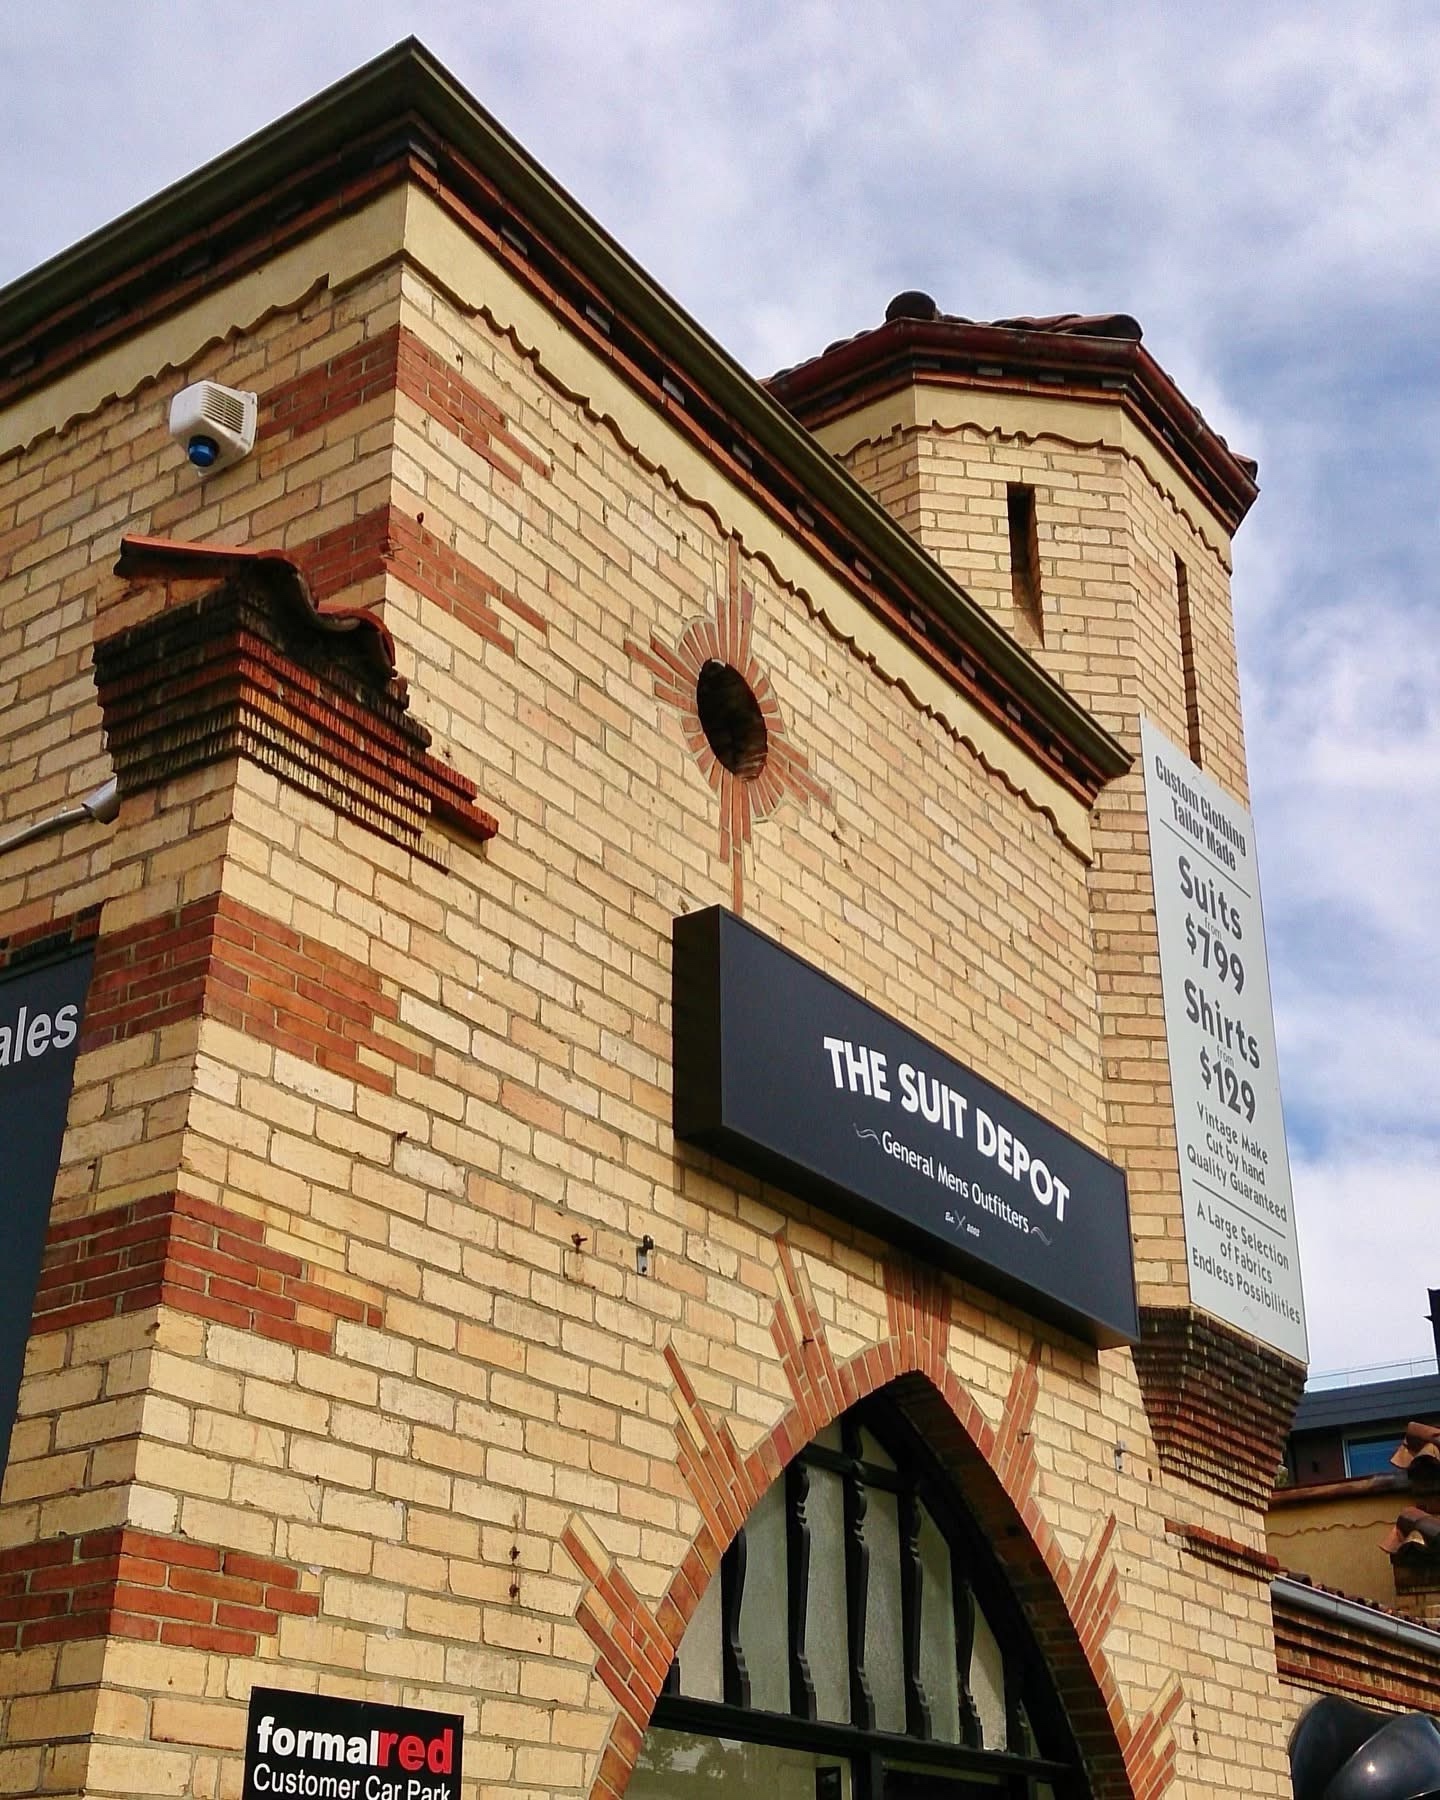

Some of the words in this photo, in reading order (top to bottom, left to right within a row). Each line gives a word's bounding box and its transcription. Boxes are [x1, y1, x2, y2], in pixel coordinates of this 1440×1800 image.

[1155, 755, 1199, 813] Custom
[1200, 796, 1247, 857] Clothing
[1171, 796, 1204, 843] Tailor
[1206, 827, 1237, 871] Made
[1178, 855, 1243, 940] Suits
[1204, 917, 1222, 940] from
[1185, 912, 1245, 995] $799
[1184, 978, 1260, 1069] Shirts
[1216, 1044, 1235, 1068] from
[1199, 1046, 1256, 1124] $129
[823, 1036, 891, 1102] THE
[898, 1063, 967, 1138] SUIT
[976, 1106, 1070, 1222] DEPOT
[1197, 1101, 1238, 1144] Vintage
[1241, 1131, 1268, 1164] Make
[1206, 1132, 1224, 1158] Cut
[1225, 1144, 1239, 1171] by
[1241, 1154, 1265, 1185] hand
[881, 1130, 934, 1179] General
[937, 1161, 969, 1198] Mens
[971, 1182, 1030, 1234] Outfitters
[1186, 1143, 1227, 1187] Quality
[1229, 1171, 1287, 1222] Guaranteed
[1197, 1199, 1206, 1221] A
[1207, 1204, 1238, 1240] Large
[1241, 1225, 1289, 1270] Selection
[1220, 1241, 1232, 1260] of
[1234, 1246, 1273, 1284] Fabrics
[1192, 1246, 1234, 1287] Endless
[1236, 1271, 1301, 1324] Possibilities
[253, 1763, 361, 1800] Customer
[365, 1775, 402, 1800] Car
[407, 1779, 451, 1800] Park
[257, 1715, 454, 1774] formalred
